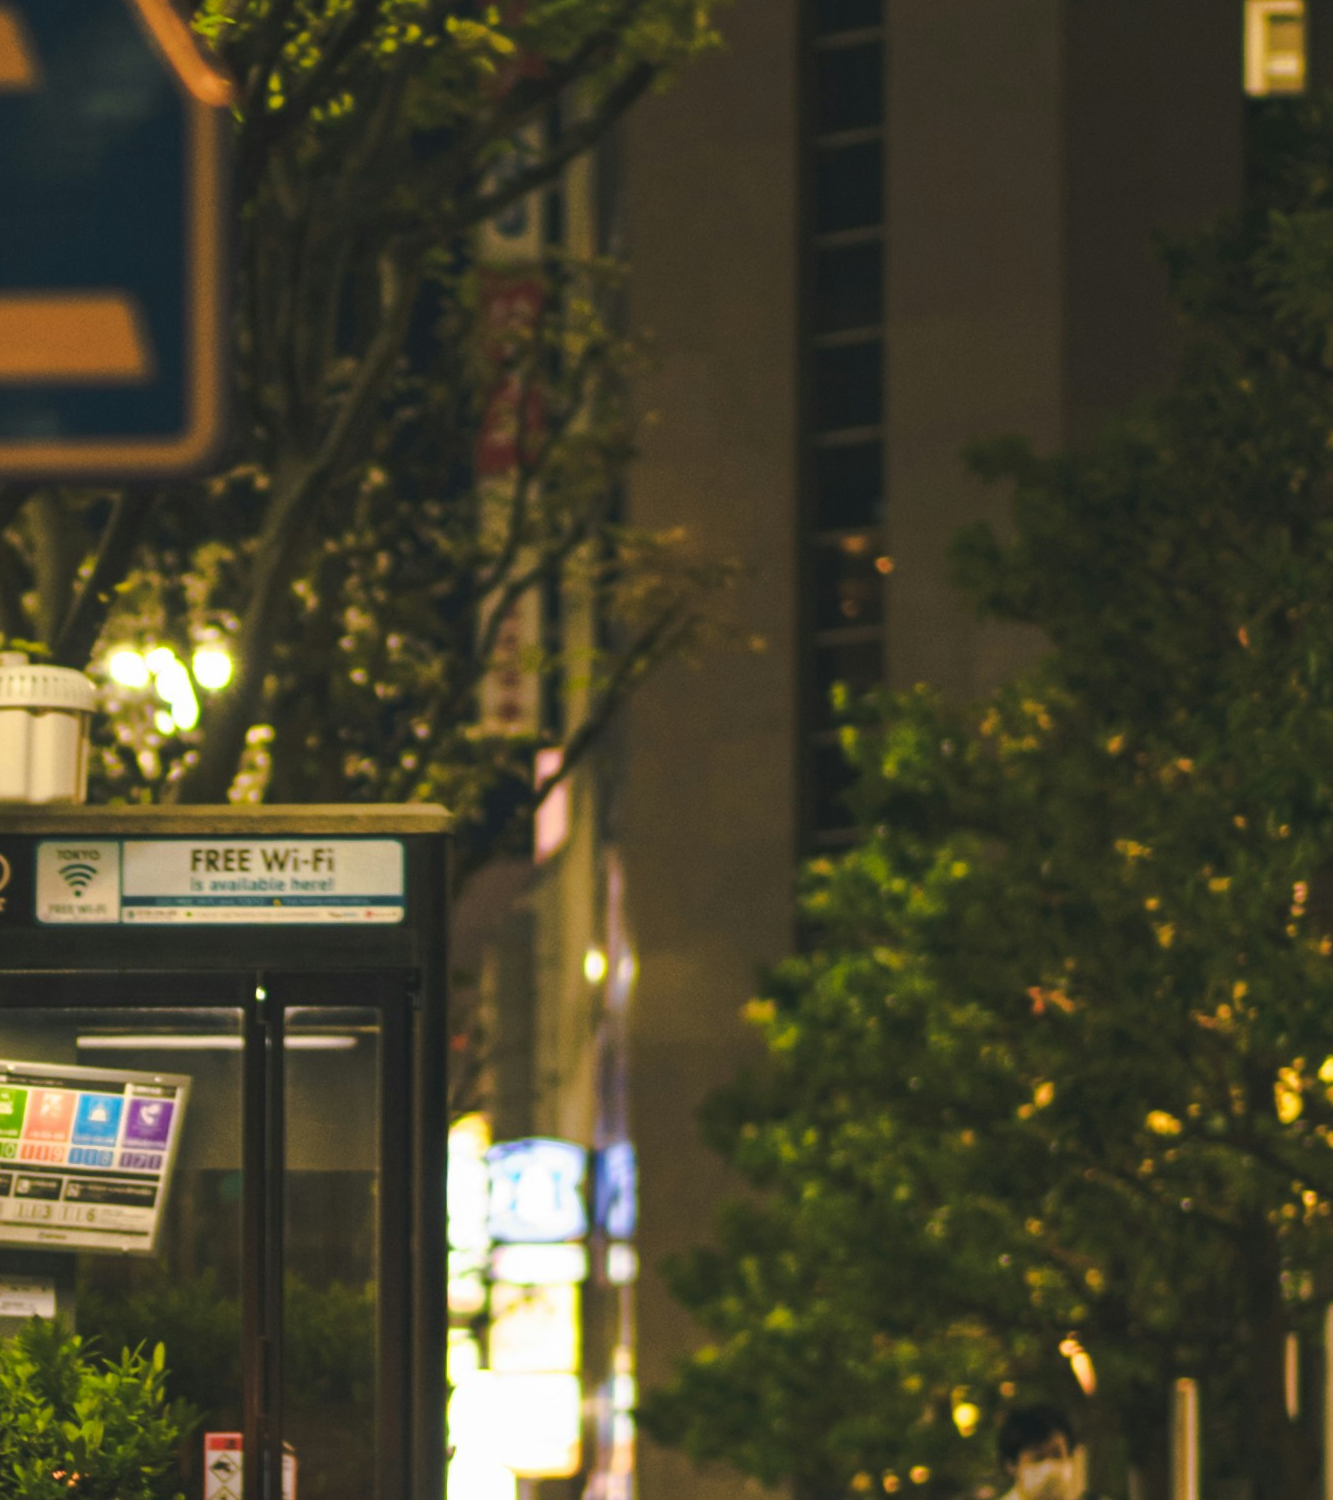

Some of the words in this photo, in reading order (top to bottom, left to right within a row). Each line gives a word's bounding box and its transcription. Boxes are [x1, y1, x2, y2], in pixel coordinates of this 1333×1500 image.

[56, 849, 101, 861] TOKYO
[190, 848, 250, 872] FREE
[260, 848, 335, 872] Wi-Fi
[190, 876, 204, 892] is
[209, 876, 285, 892] available
[290, 876, 335, 892] here!
[48, 903, 74, 914] FREE
[21, 1144, 64, 1163] 119
[18, 1202, 52, 1218] 113
[63, 1206, 96, 1222] 116
